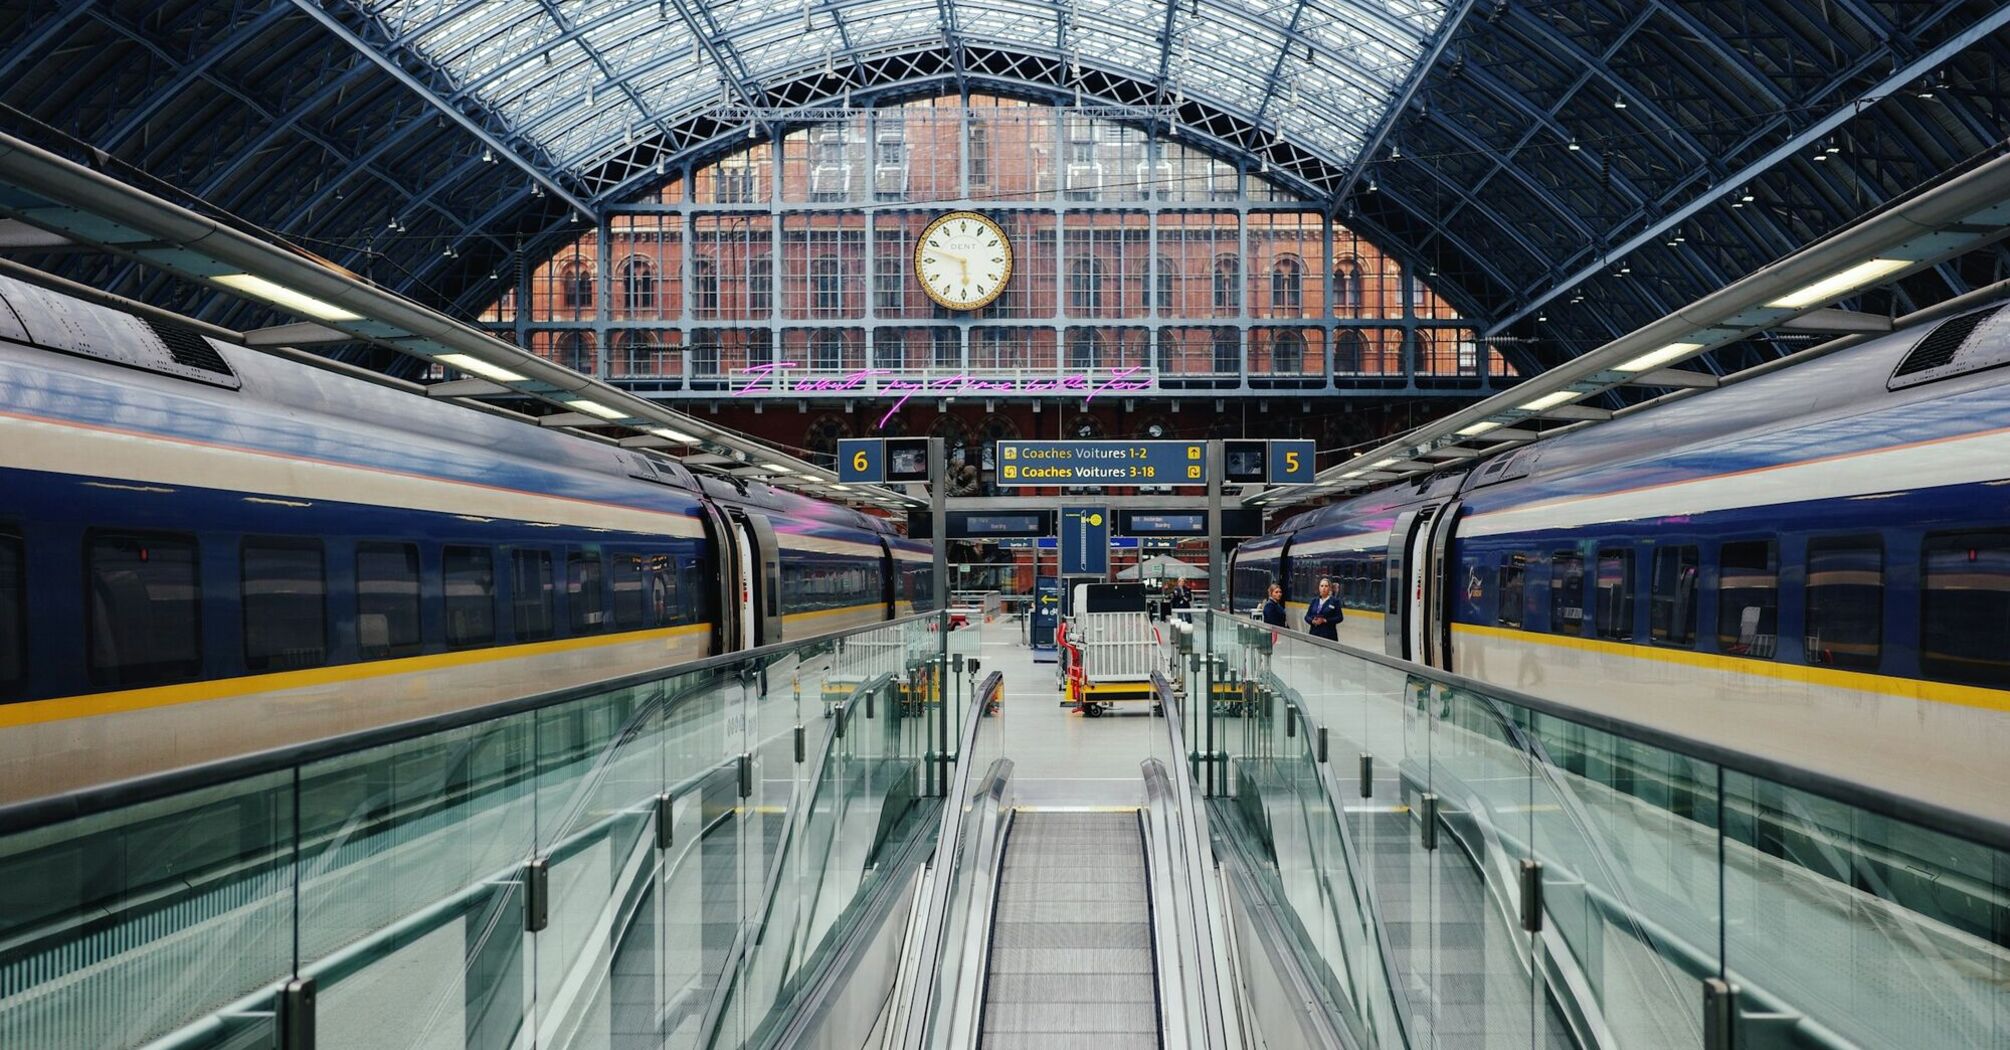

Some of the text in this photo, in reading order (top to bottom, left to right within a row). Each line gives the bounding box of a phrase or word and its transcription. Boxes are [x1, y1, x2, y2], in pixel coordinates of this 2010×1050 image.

[732, 362, 797, 397] I
[853, 450, 868, 472] 6
[1021, 447, 1147, 459] Coaches Voitures 1-2
[1286, 452, 1299, 473] 5
[1021, 466, 1155, 478] Coaches Voitures 3-18
